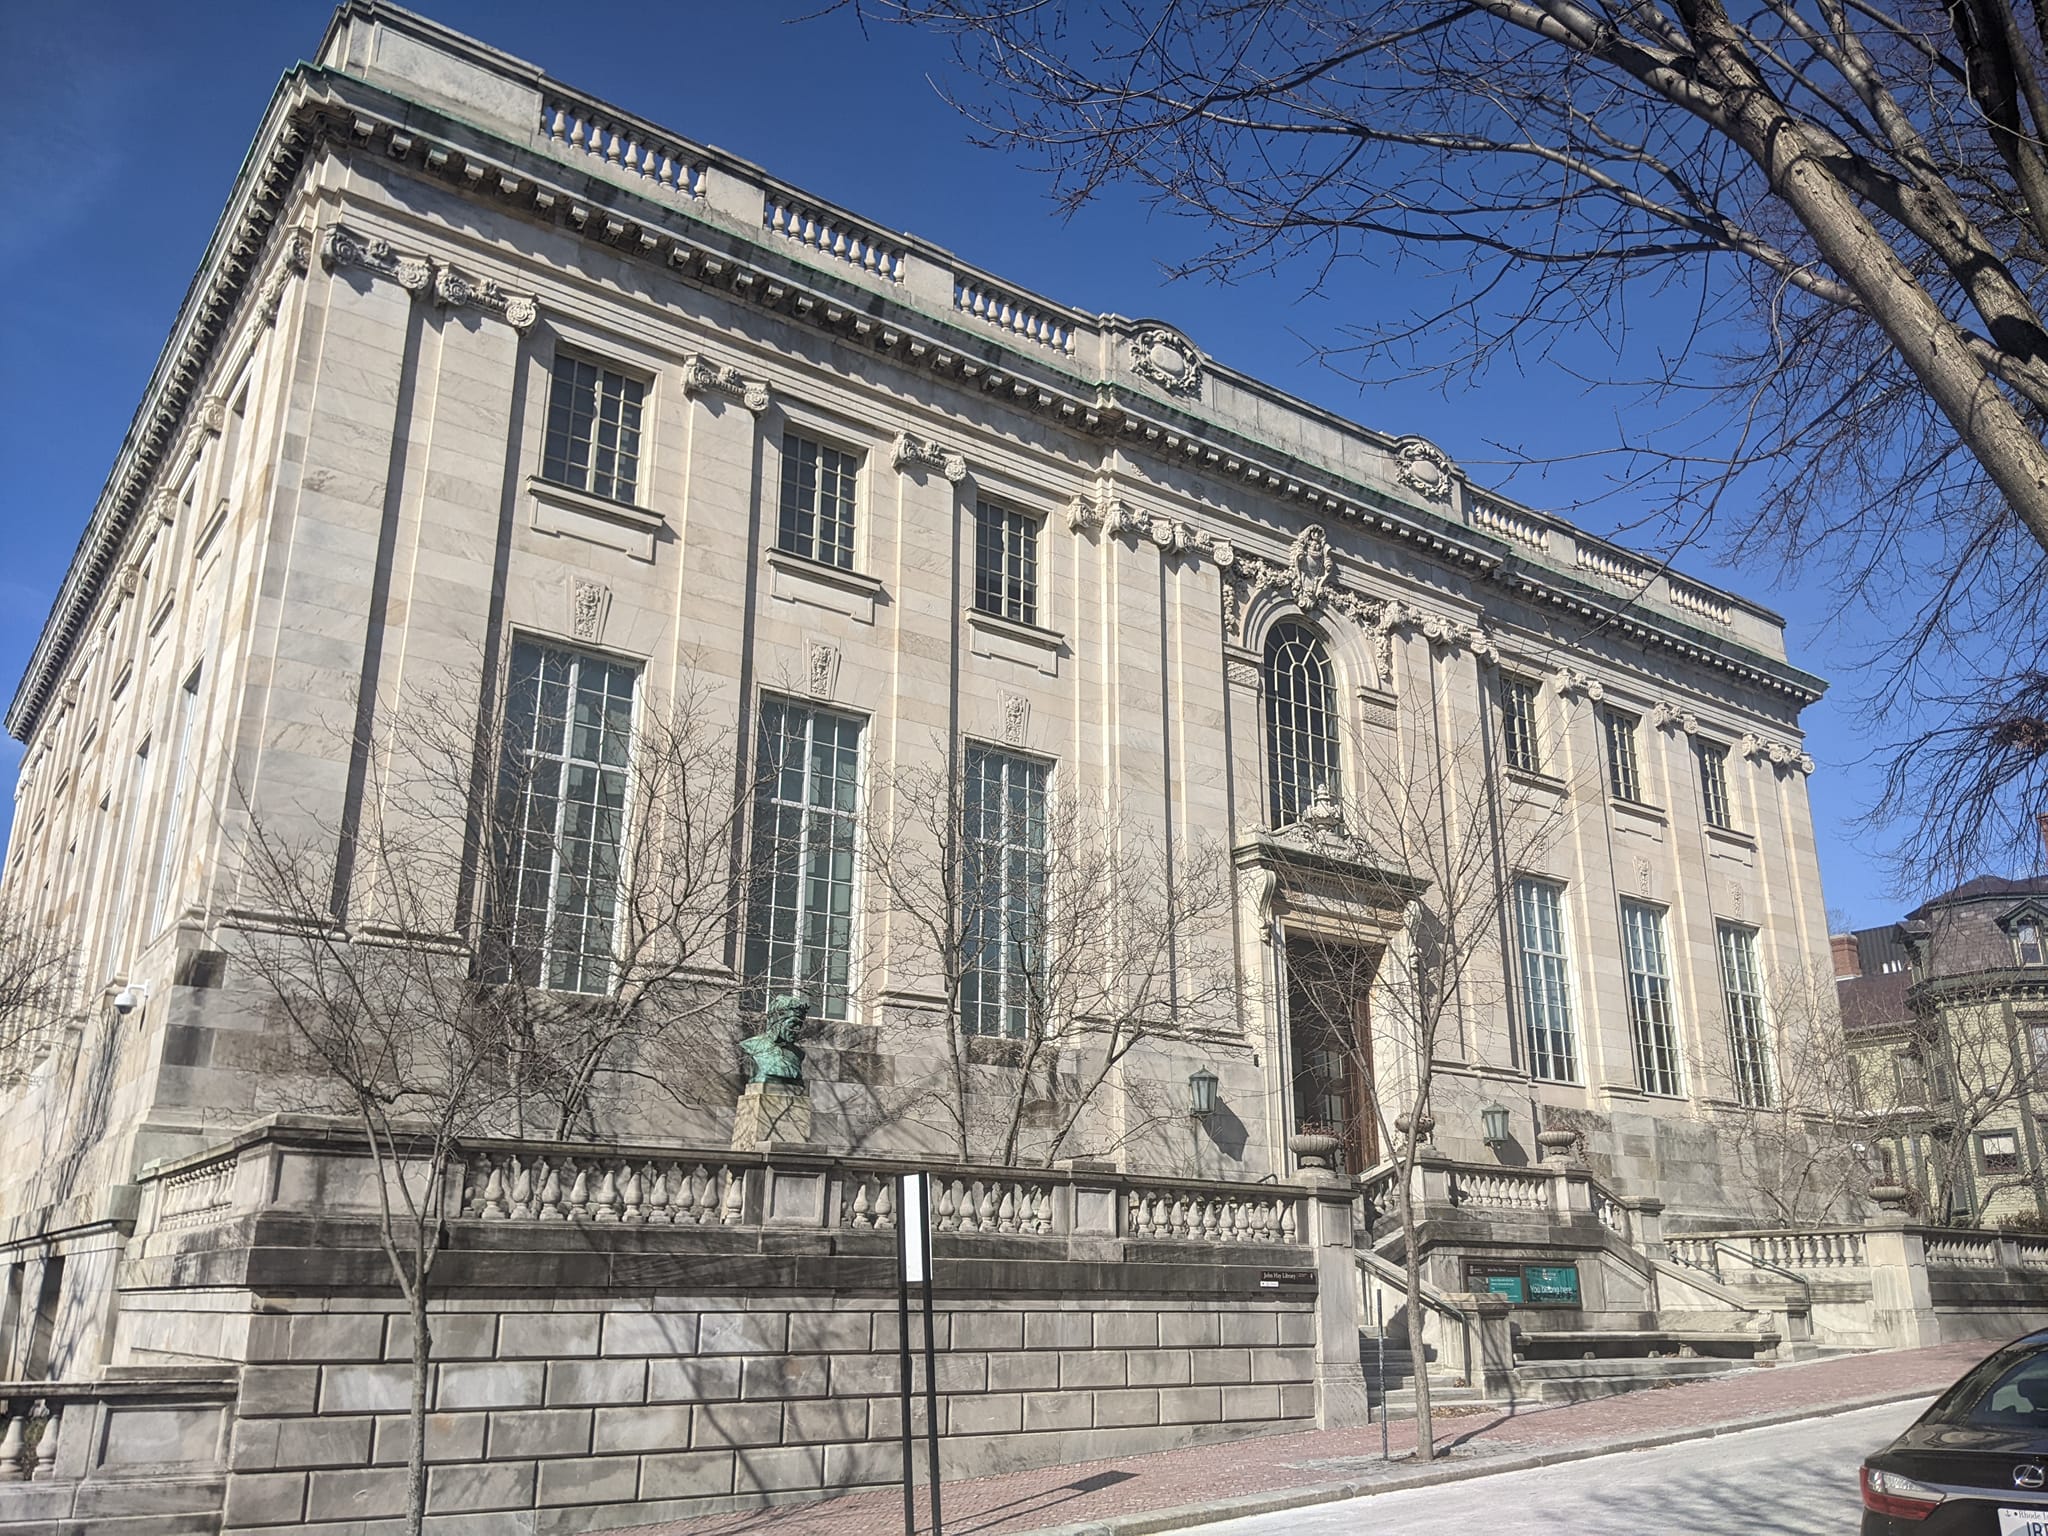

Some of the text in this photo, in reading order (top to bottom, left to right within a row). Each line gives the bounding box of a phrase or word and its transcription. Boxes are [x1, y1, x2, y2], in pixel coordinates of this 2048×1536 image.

[1282, 1272, 1296, 1280] Library
[1530, 1285, 1541, 1293] You
[2018, 1511, 2040, 1519] Rhode
